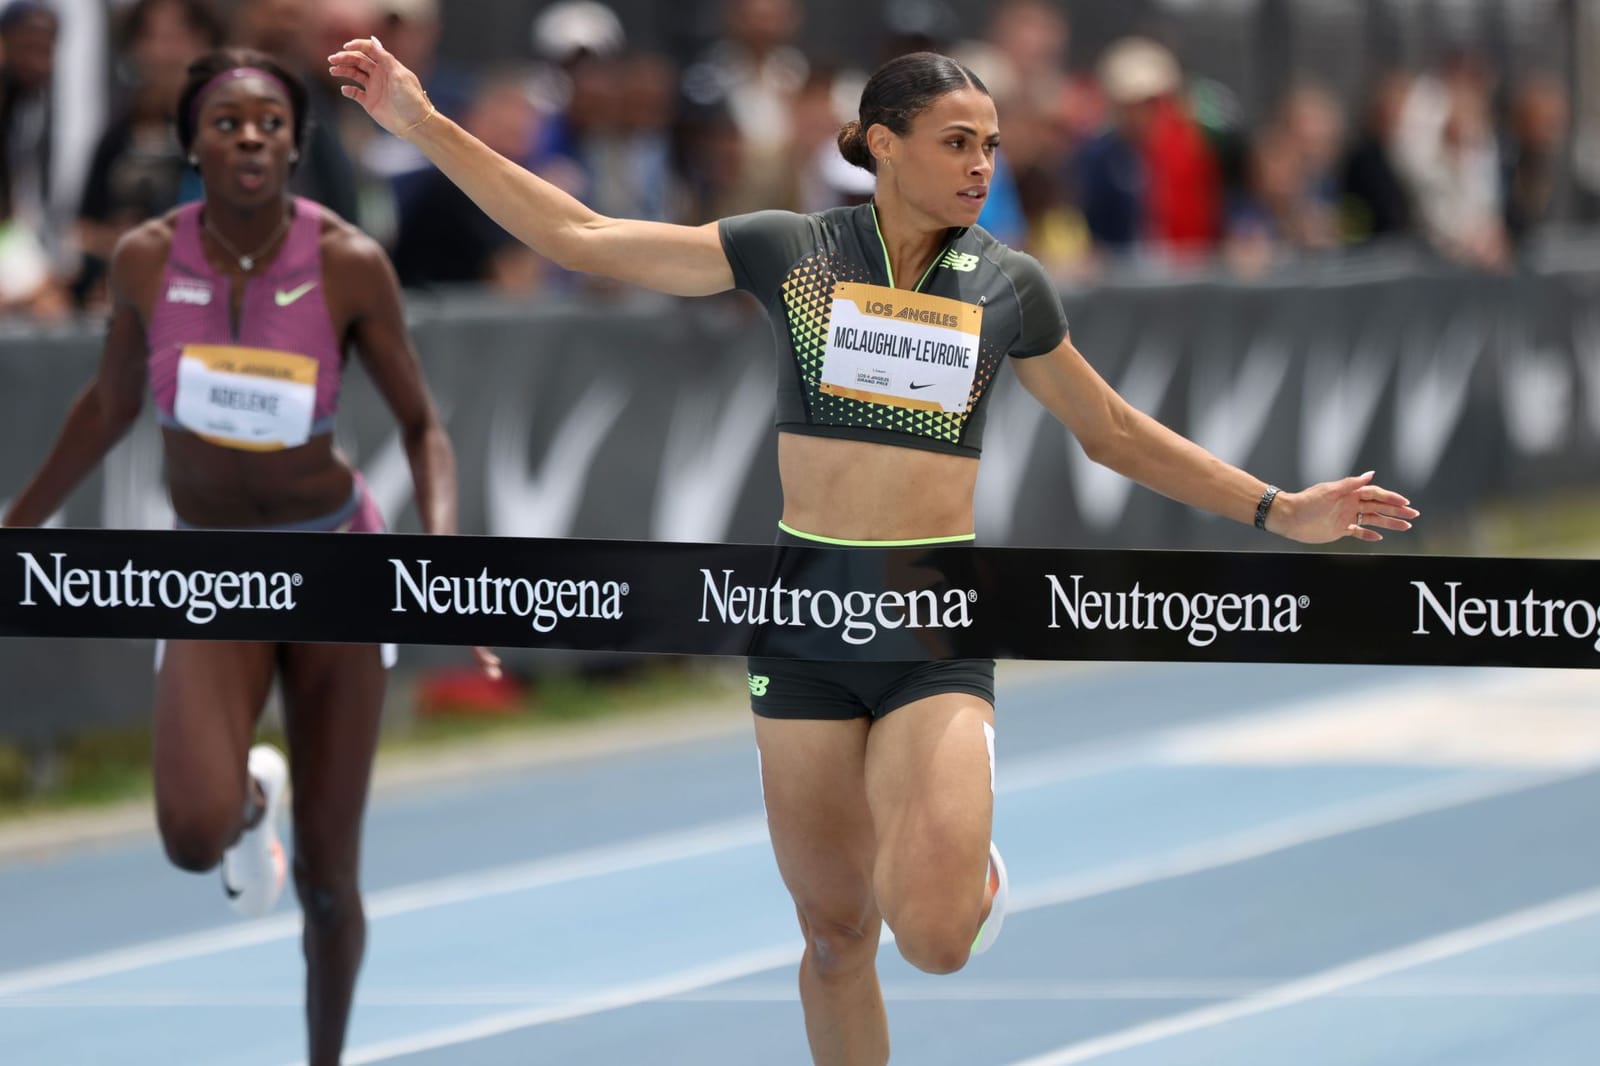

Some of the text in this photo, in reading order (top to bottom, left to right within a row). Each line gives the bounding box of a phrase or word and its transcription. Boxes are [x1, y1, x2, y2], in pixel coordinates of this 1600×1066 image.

[865, 301, 958, 328] LOS ANGELES
[834, 326, 971, 369] MCLAUGHLIN-LEVRONE
[1410, 580, 1600, 653] Neutro
